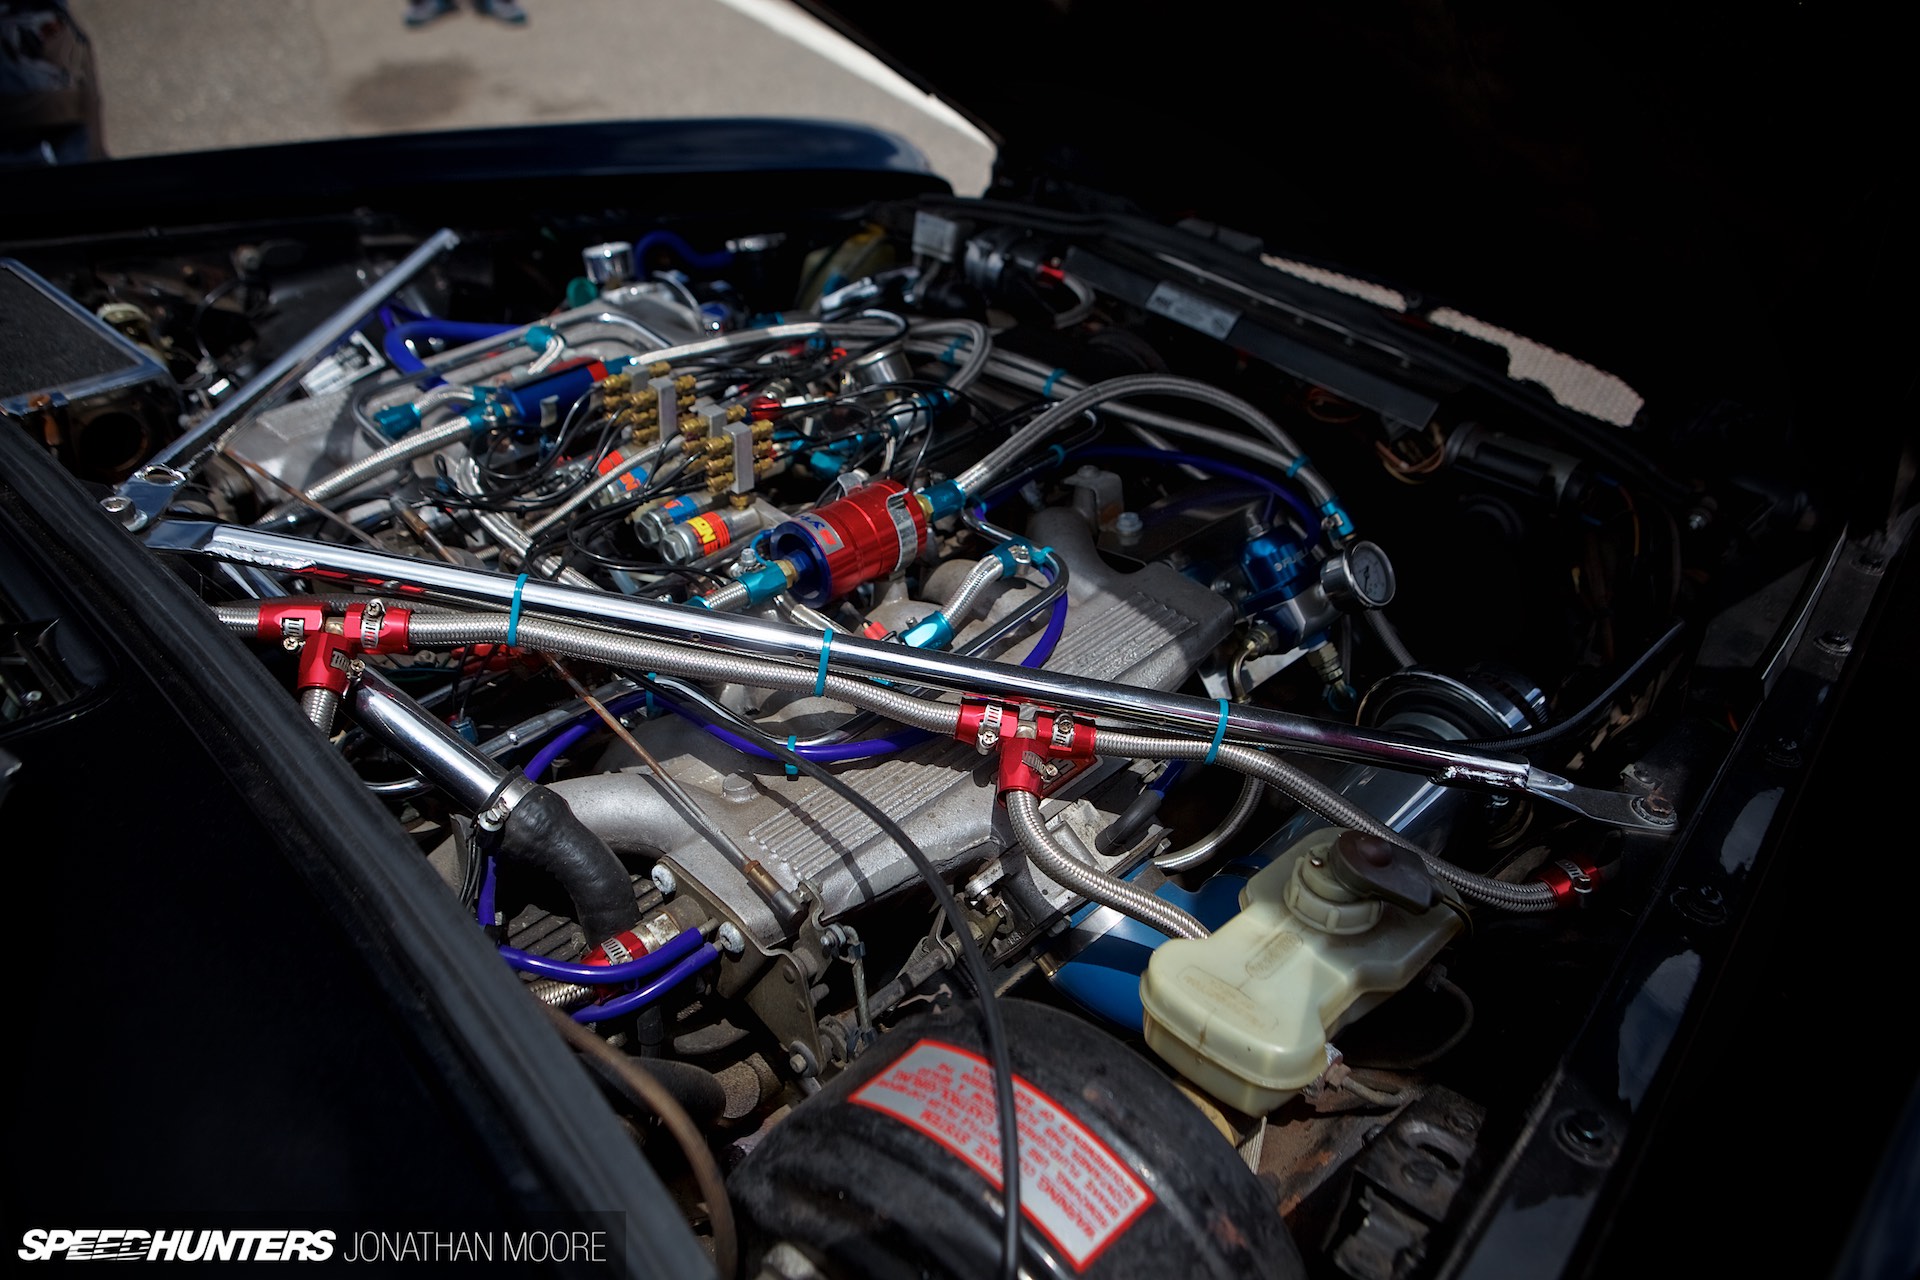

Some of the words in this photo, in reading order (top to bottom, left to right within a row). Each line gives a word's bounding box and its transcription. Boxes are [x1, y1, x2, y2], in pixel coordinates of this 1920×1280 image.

[1026, 1146, 1050, 1169] USE
[1035, 1175, 1097, 1240] WARNING
[1083, 1179, 1119, 1219] BRAKE
